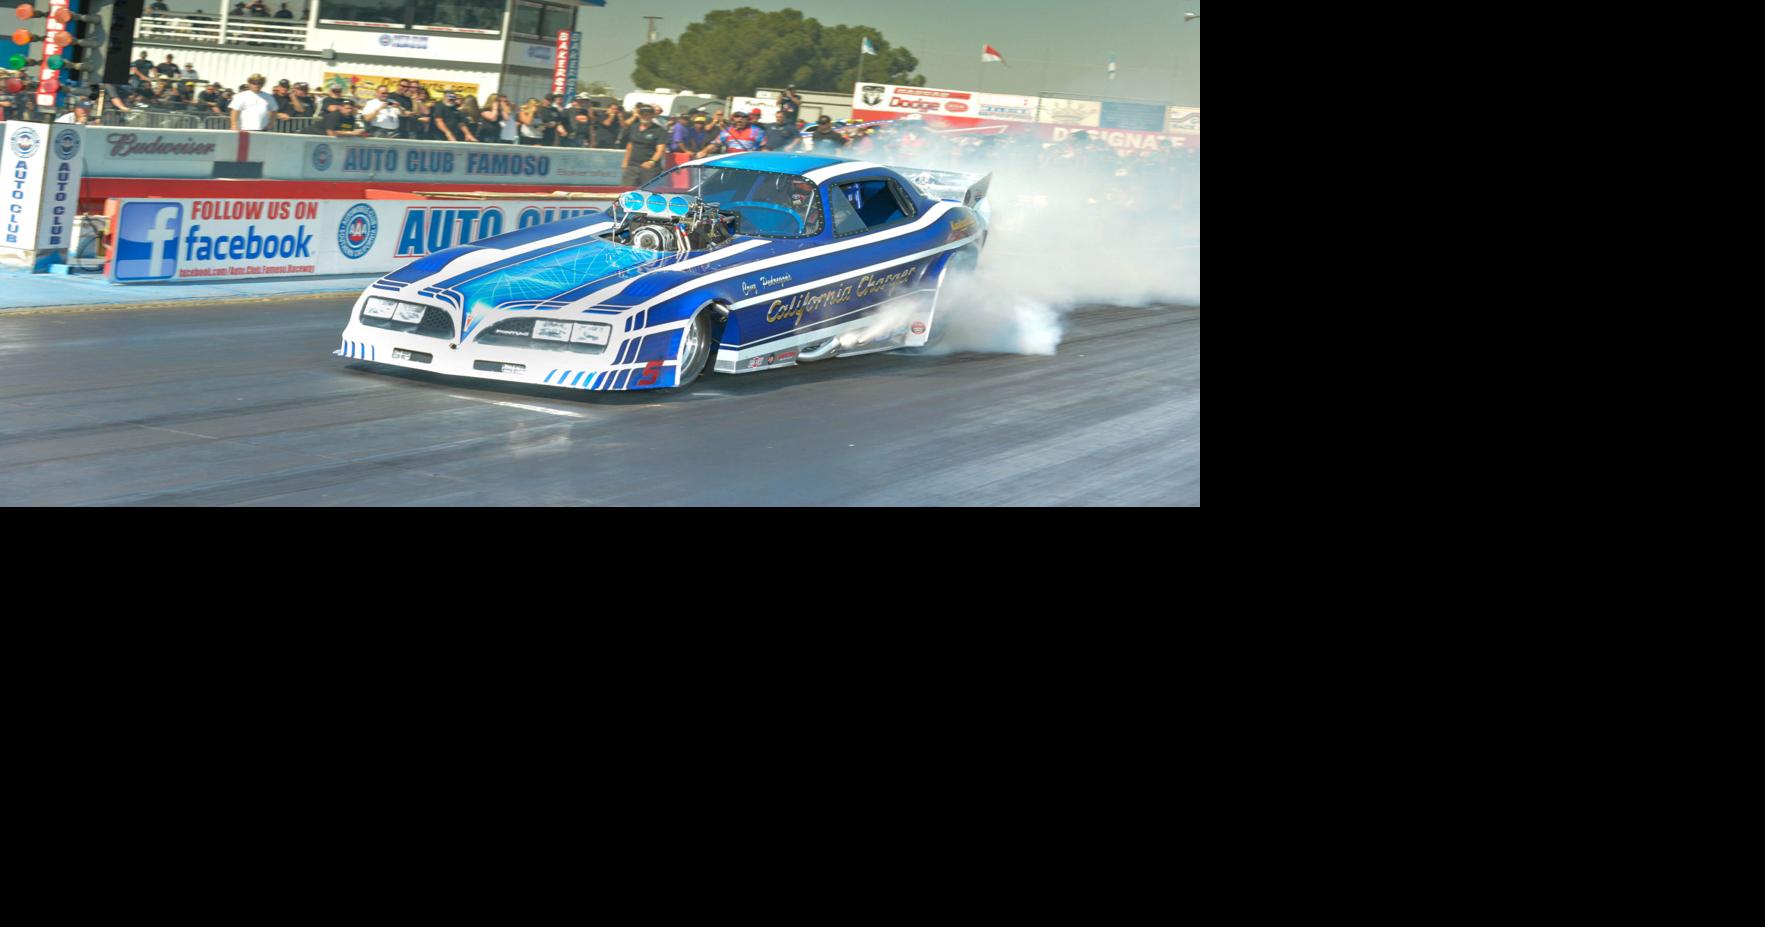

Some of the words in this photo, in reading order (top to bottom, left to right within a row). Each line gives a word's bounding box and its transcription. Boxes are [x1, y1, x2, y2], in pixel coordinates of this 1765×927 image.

[889, 97, 940, 112] Dodge
[106, 132, 216, 157] Budweiser
[1053, 128, 1186, 151] DSIGNAE
[12, 160, 28, 200] AUTO
[343, 147, 398, 172] AUTO
[406, 149, 454, 173] CLUB
[466, 153, 549, 176] FAMOSO
[55, 162, 71, 202] AUTO
[6, 204, 22, 243] CLUB
[49, 206, 65, 245] CLUB
[191, 201, 264, 220] FOLLOW
[267, 201, 291, 220] US
[294, 201, 319, 220] ON
[185, 224, 313, 261] facebook
[396, 207, 504, 256] AUTO
[766, 283, 852, 326] California
[856, 266, 917, 298] Charger
[637, 360, 665, 386] 5
